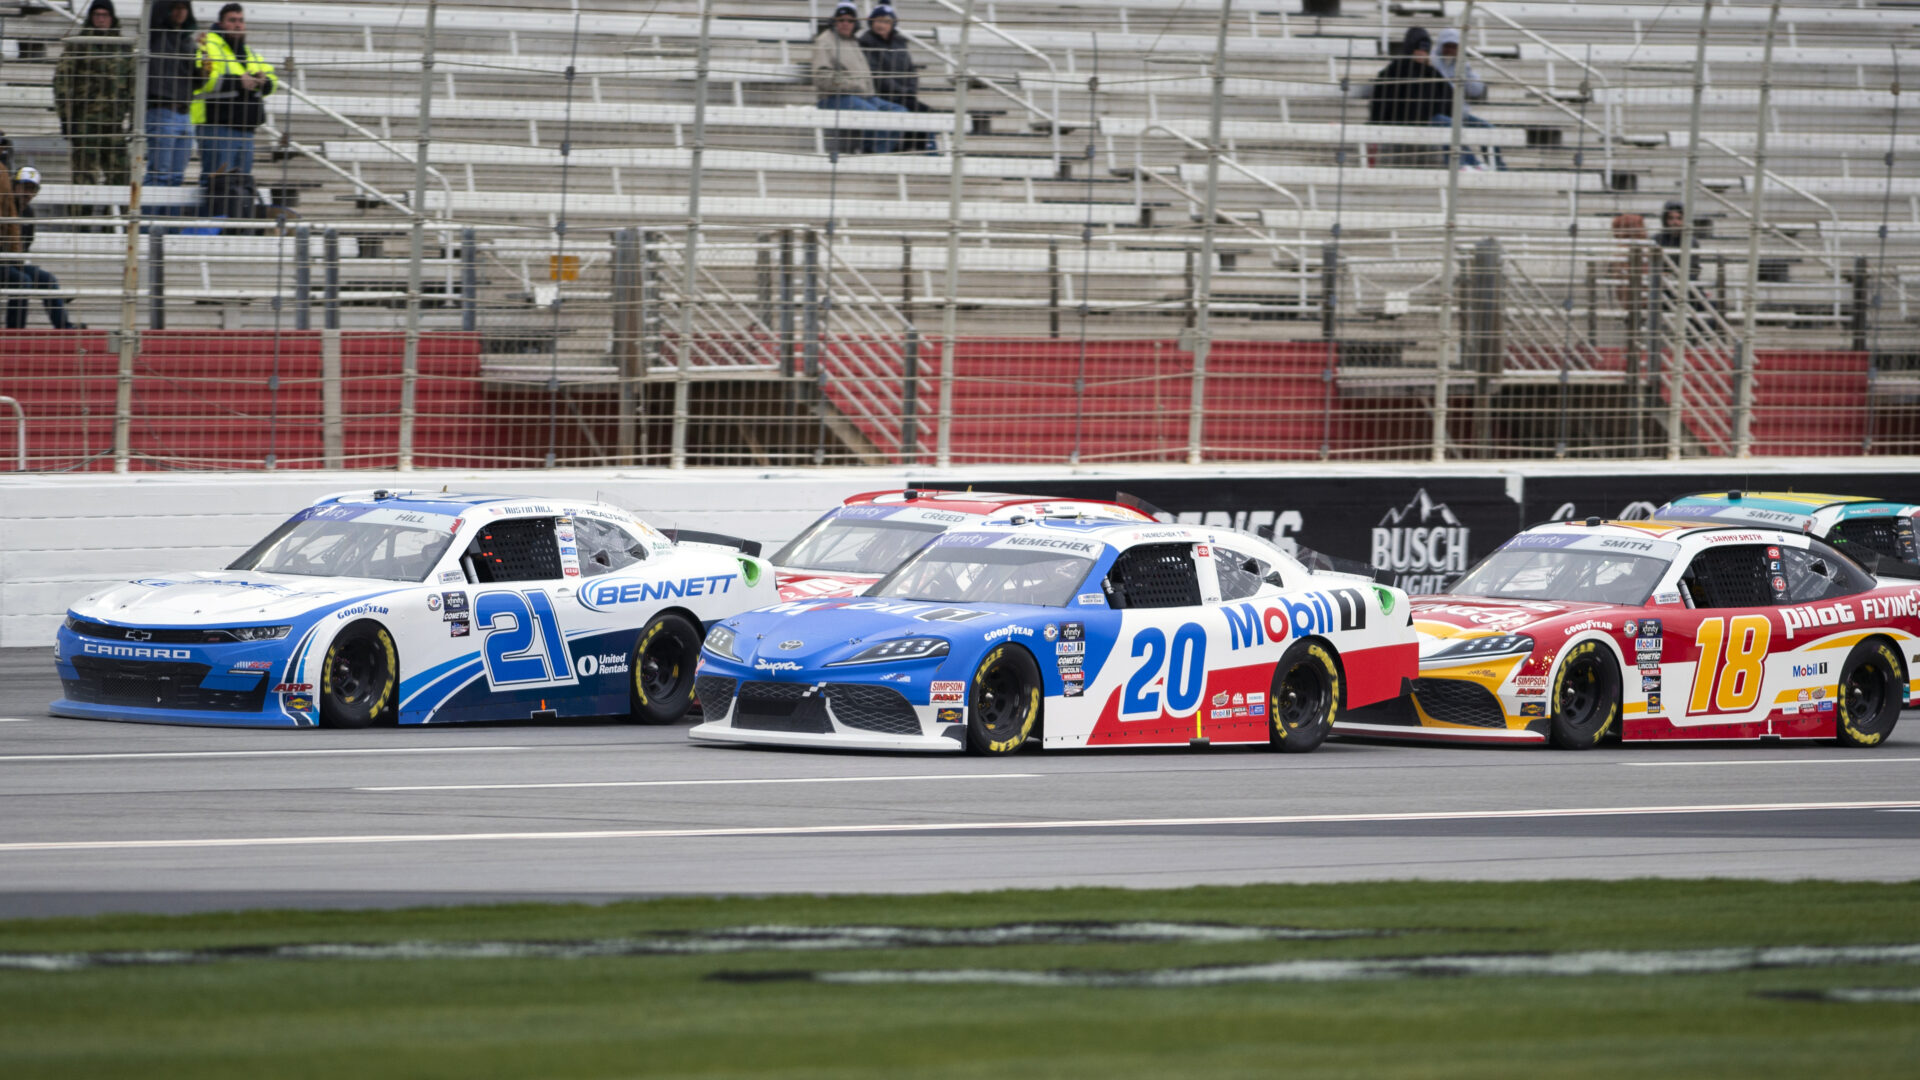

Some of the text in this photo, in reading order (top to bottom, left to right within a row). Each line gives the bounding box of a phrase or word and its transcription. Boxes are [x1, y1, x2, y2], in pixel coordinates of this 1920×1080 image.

[395, 513, 425, 524] HILL
[921, 511, 965, 523] CREED
[1745, 509, 1796, 523] SMITH
[1006, 536, 1094, 553] NEMECHEK
[1600, 538, 1654, 552] SMITH
[1712, 535, 1738, 543] SAMMY
[1371, 526, 1468, 573] BUSCH
[596, 574, 737, 605] BENNETT
[337, 603, 390, 621] GOODYEAR
[1861, 594, 1918, 621] FLYING
[444, 611, 469, 620] COMETIC
[1219, 591, 1334, 651] Mobil
[1327, 588, 1367, 632] 1
[984, 624, 1034, 641] GOODYEAR
[1564, 620, 1613, 635] GOODYEAR
[474, 589, 574, 687] 21
[1637, 639, 1654, 649] Mobil
[84, 643, 191, 659] CAMARO
[1058, 643, 1075, 652] Mobil
[599, 652, 628, 665] United
[1686, 614, 1772, 717] 18
[599, 663, 629, 675] Rentals
[755, 659, 804, 676] Supra
[1122, 621, 1207, 715] 20
[1792, 662, 1828, 678] Mobil 1
[272, 683, 314, 692] ARP
[932, 681, 963, 692] SIMPSON
[1517, 677, 1547, 686] SIMPSON
